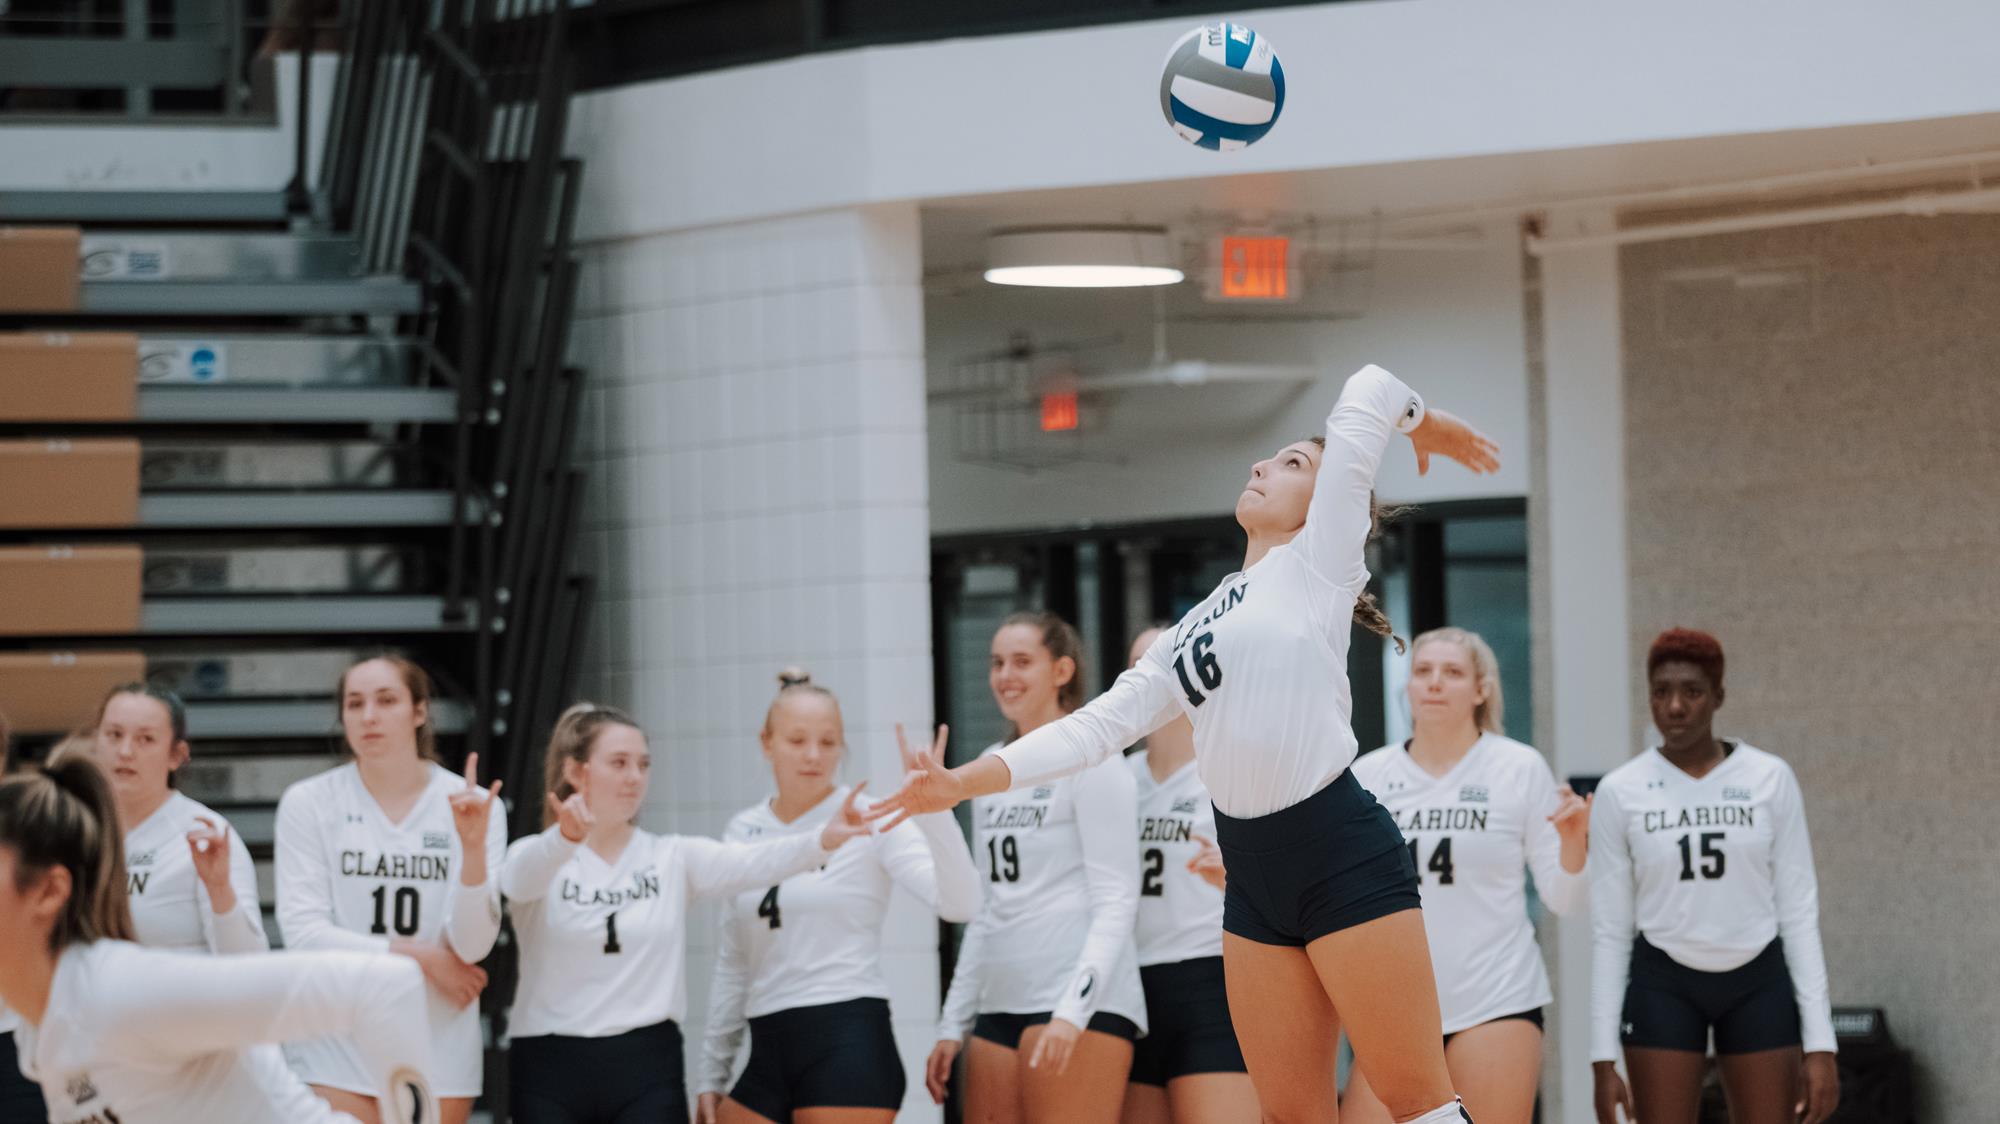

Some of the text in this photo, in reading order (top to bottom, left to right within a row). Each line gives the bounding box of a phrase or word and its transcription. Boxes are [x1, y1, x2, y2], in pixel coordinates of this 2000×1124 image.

[1172, 631, 1223, 708] 16
[1644, 806, 1753, 834] CLARION
[341, 850, 450, 882] CLARION
[987, 835, 1020, 883] 19
[1677, 832, 1726, 881] 15
[370, 885, 420, 937] 10
[757, 884, 782, 930] 4
[603, 911, 621, 954] 1
